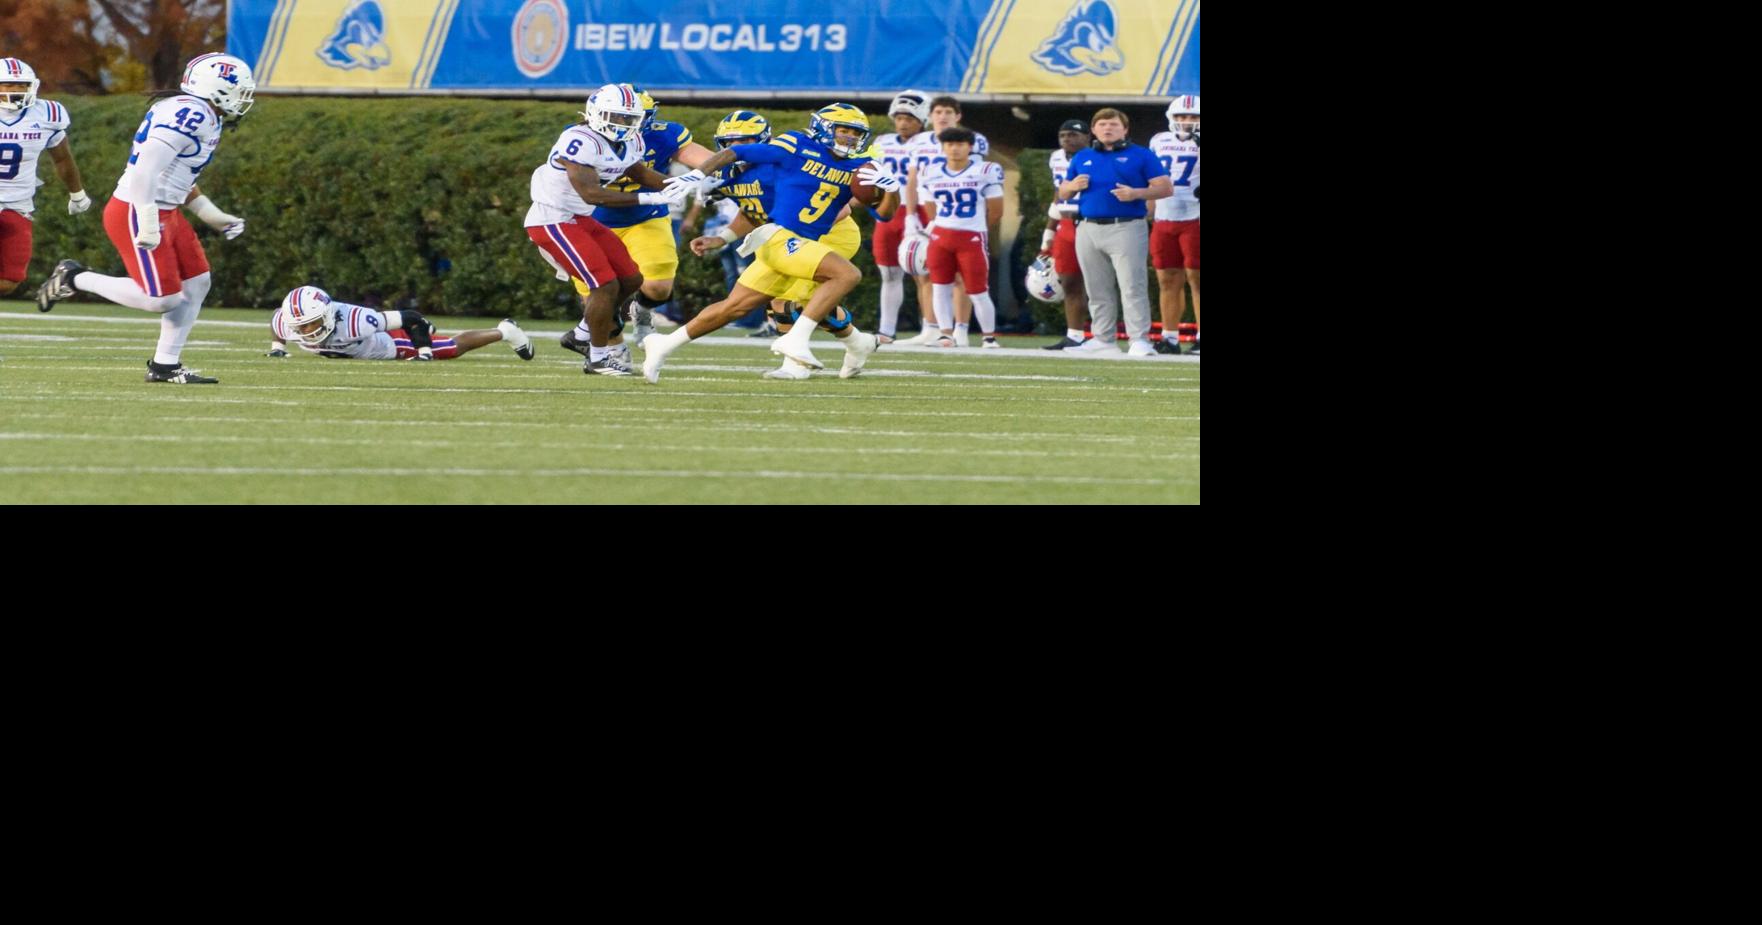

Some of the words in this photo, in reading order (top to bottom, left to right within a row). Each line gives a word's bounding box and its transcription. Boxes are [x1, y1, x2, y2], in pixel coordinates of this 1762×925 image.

[575, 23, 656, 50] IBEW
[659, 23, 775, 51] LOCAL
[779, 24, 847, 51] 313
[175, 107, 205, 132] 42
[22, 132, 42, 140] TECH
[566, 139, 583, 156] 6
[0, 143, 23, 180] 9
[720, 180, 764, 197] LAWARE
[799, 181, 840, 224] 9
[934, 187, 978, 219] 38
[365, 314, 379, 328] 8
